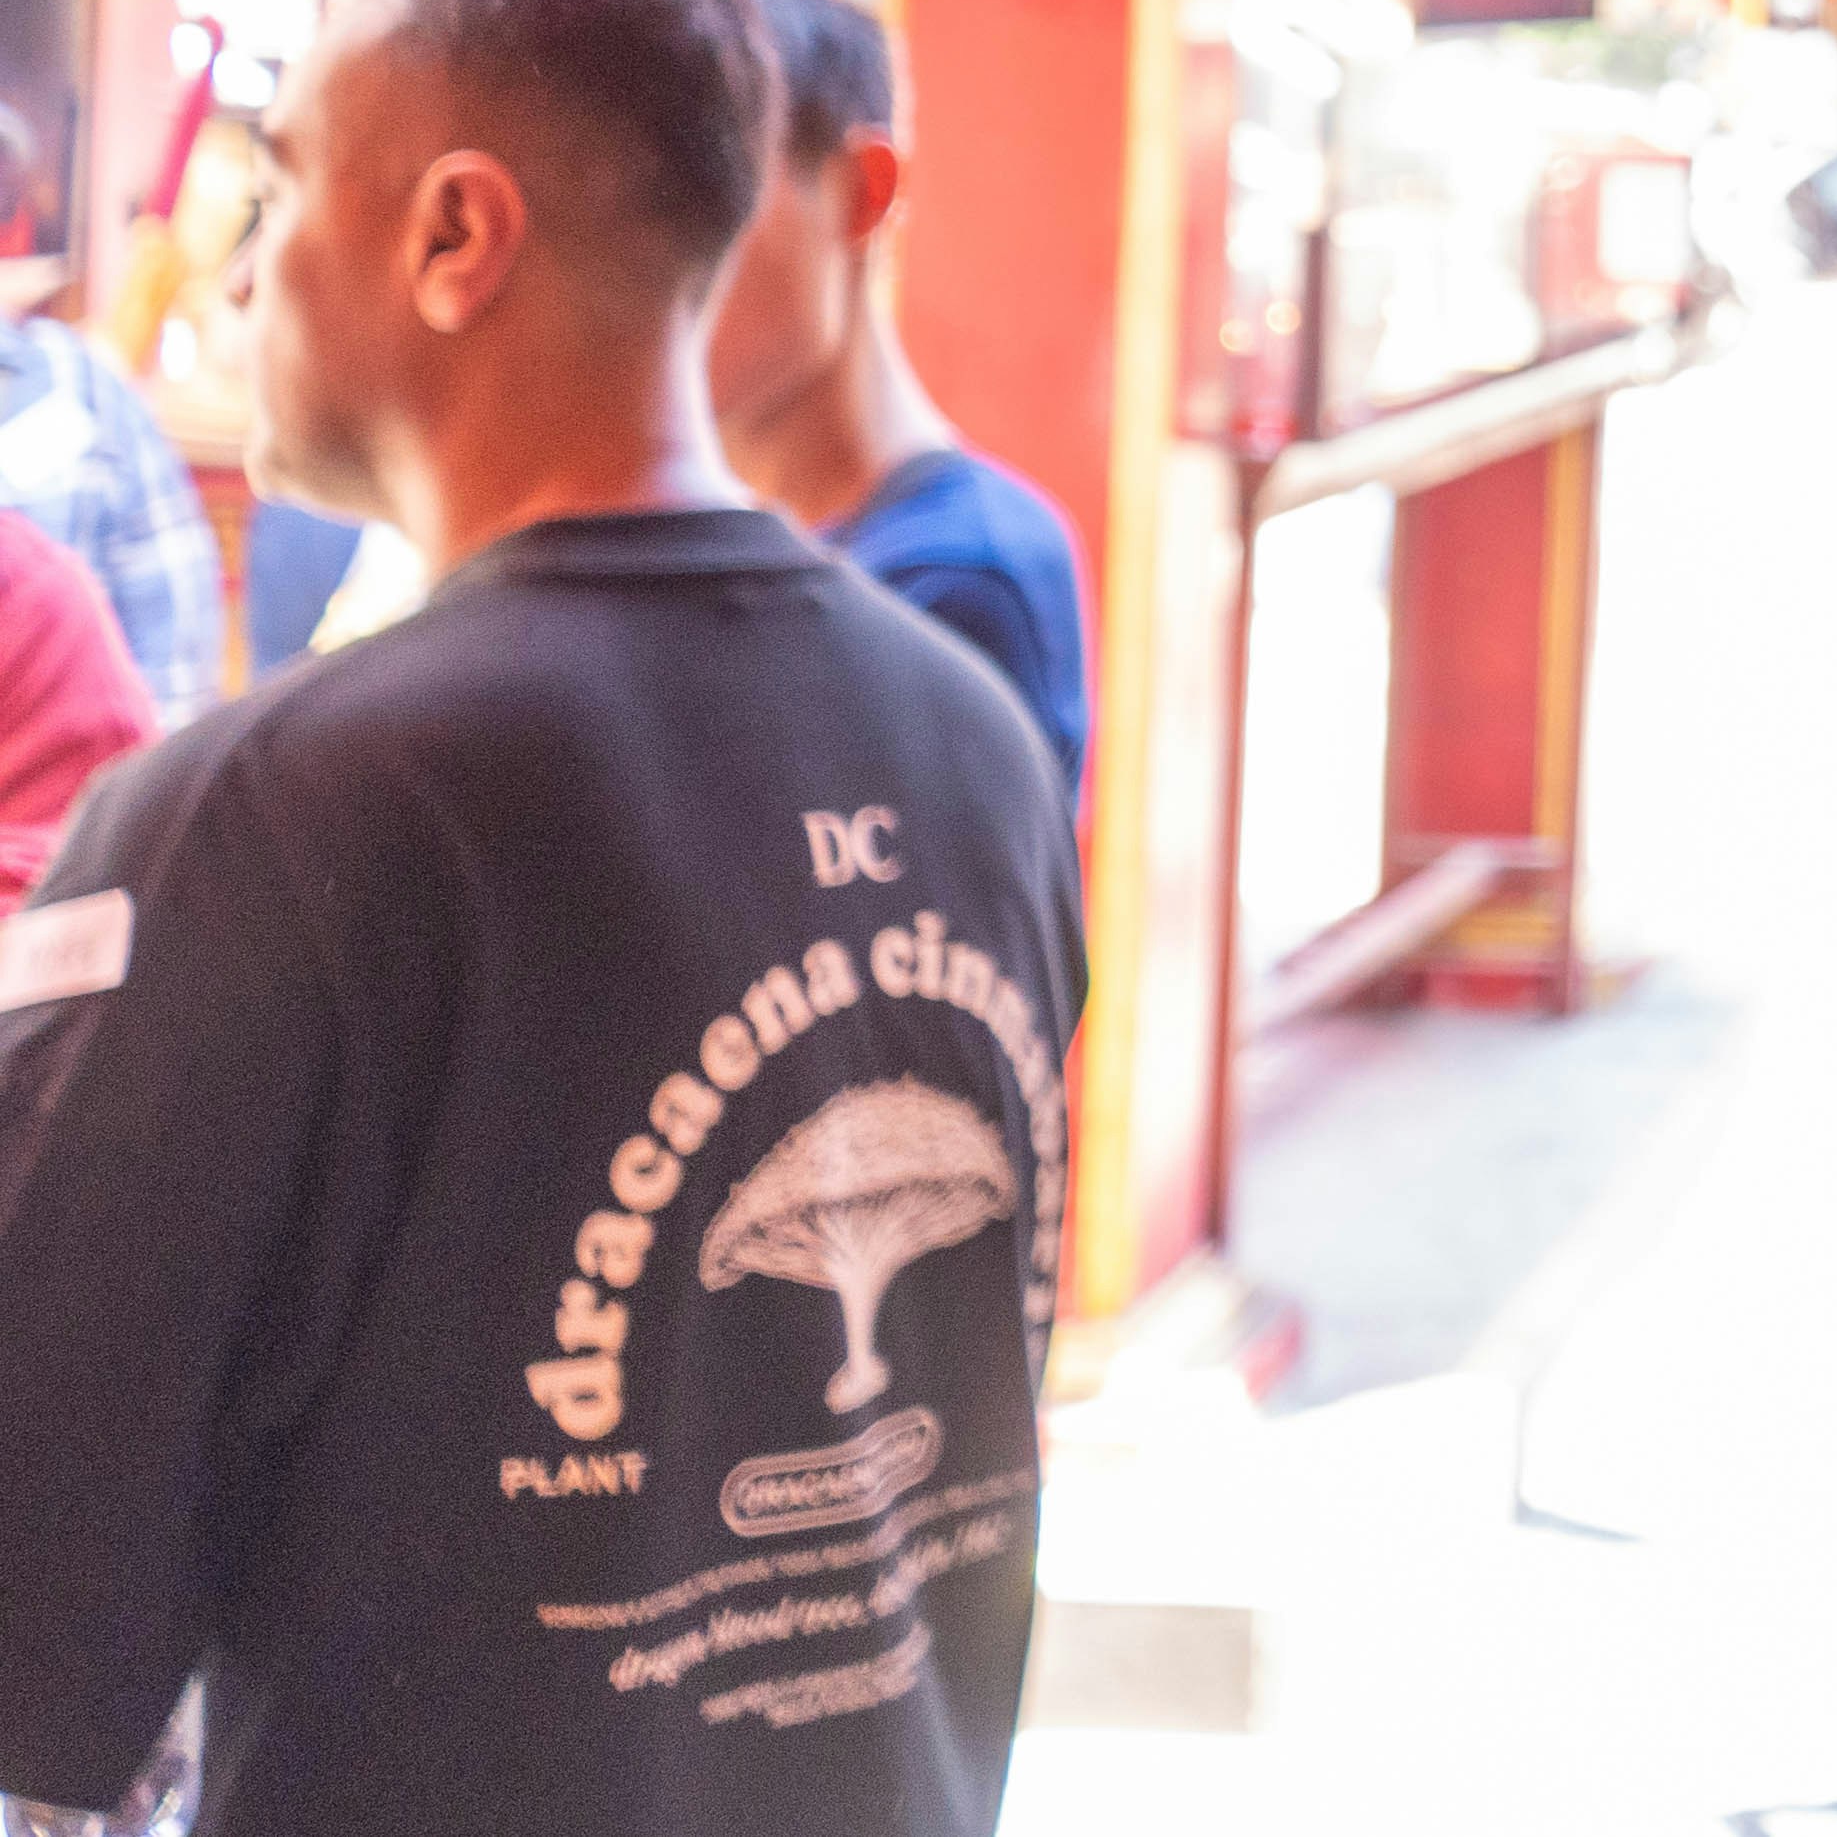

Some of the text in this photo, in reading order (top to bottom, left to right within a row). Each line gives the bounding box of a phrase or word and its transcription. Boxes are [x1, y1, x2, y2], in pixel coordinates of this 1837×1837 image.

[803, 804, 901, 888] DC
[524, 939, 860, 1440] dracaena
[499, 1451, 649, 1500] PLANT
